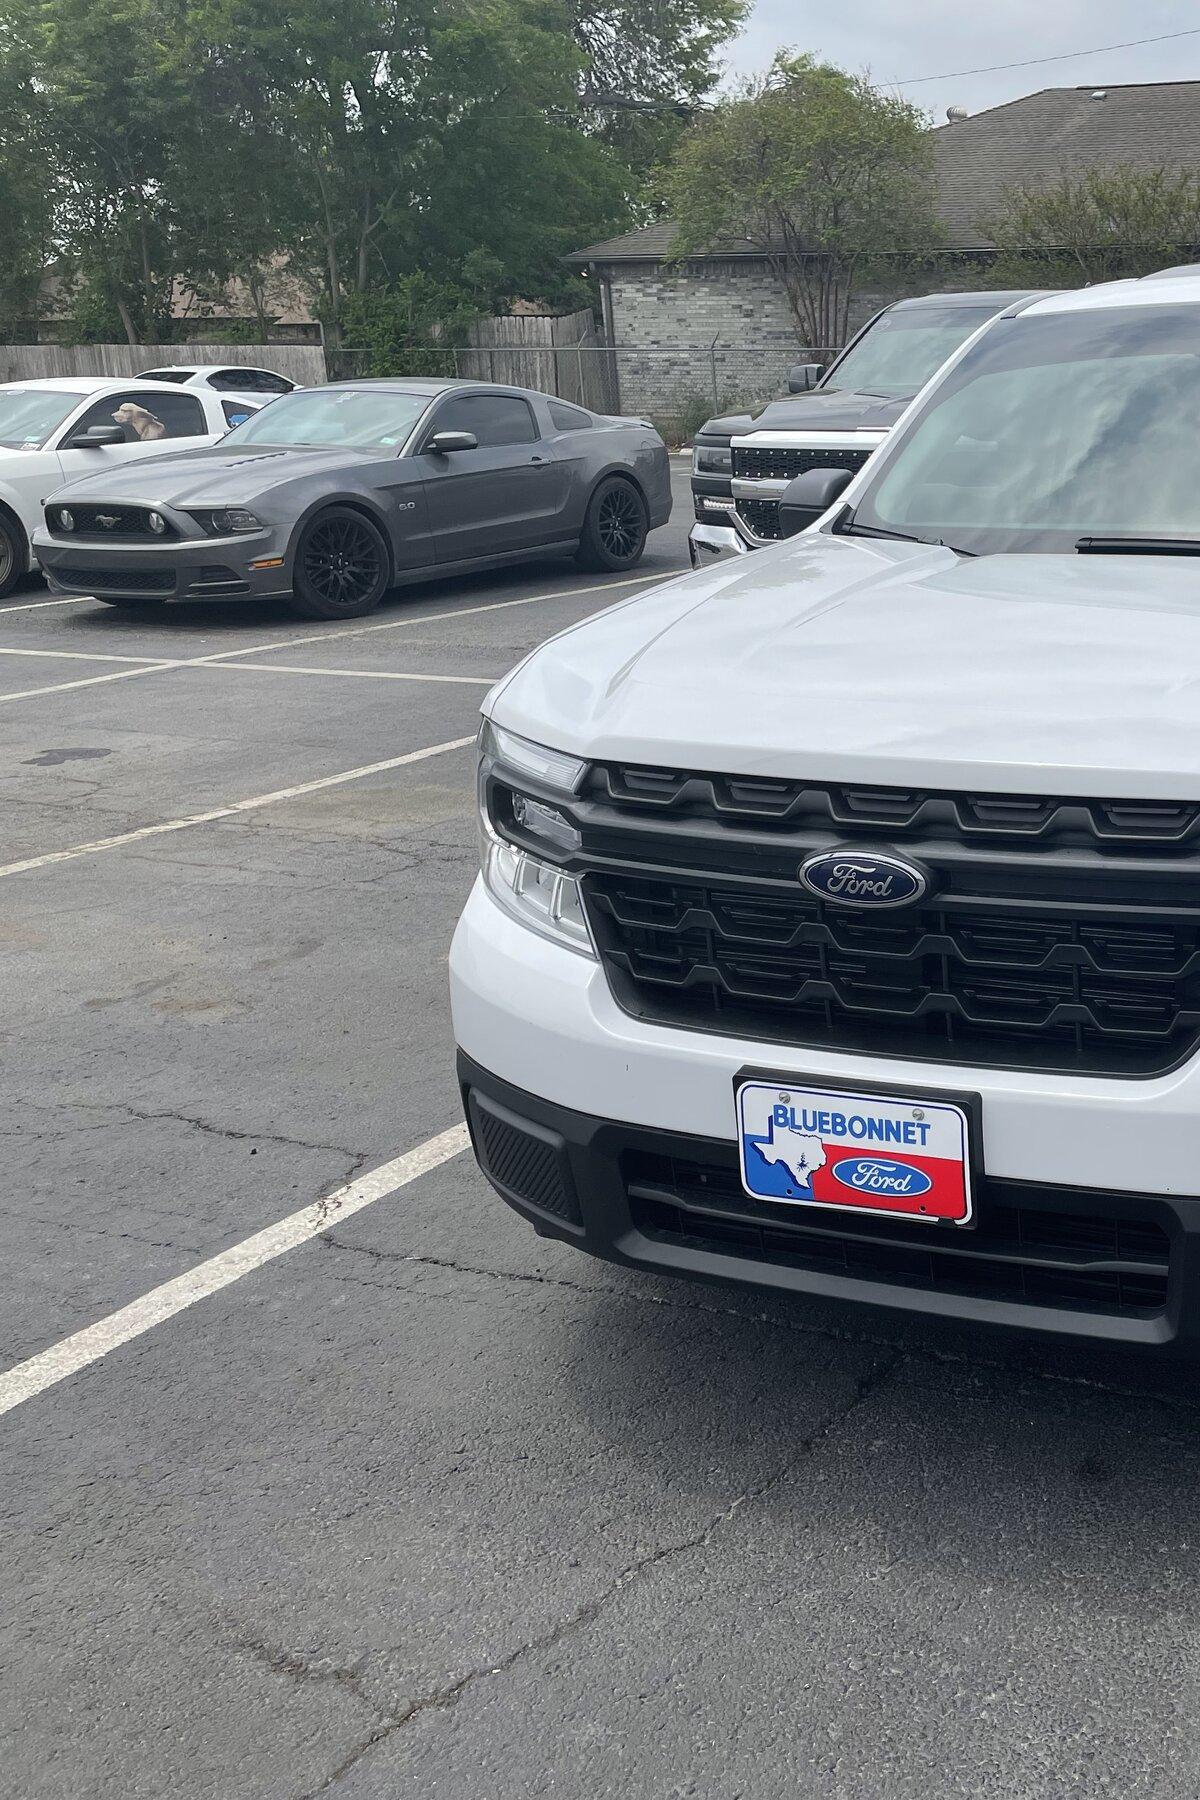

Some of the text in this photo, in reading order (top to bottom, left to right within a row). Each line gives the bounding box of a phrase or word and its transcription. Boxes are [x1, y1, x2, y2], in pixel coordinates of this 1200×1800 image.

[827, 863, 893, 896] Ford
[773, 1104, 931, 1146] BLUEBONNET
[851, 1162, 912, 1192] Ford
